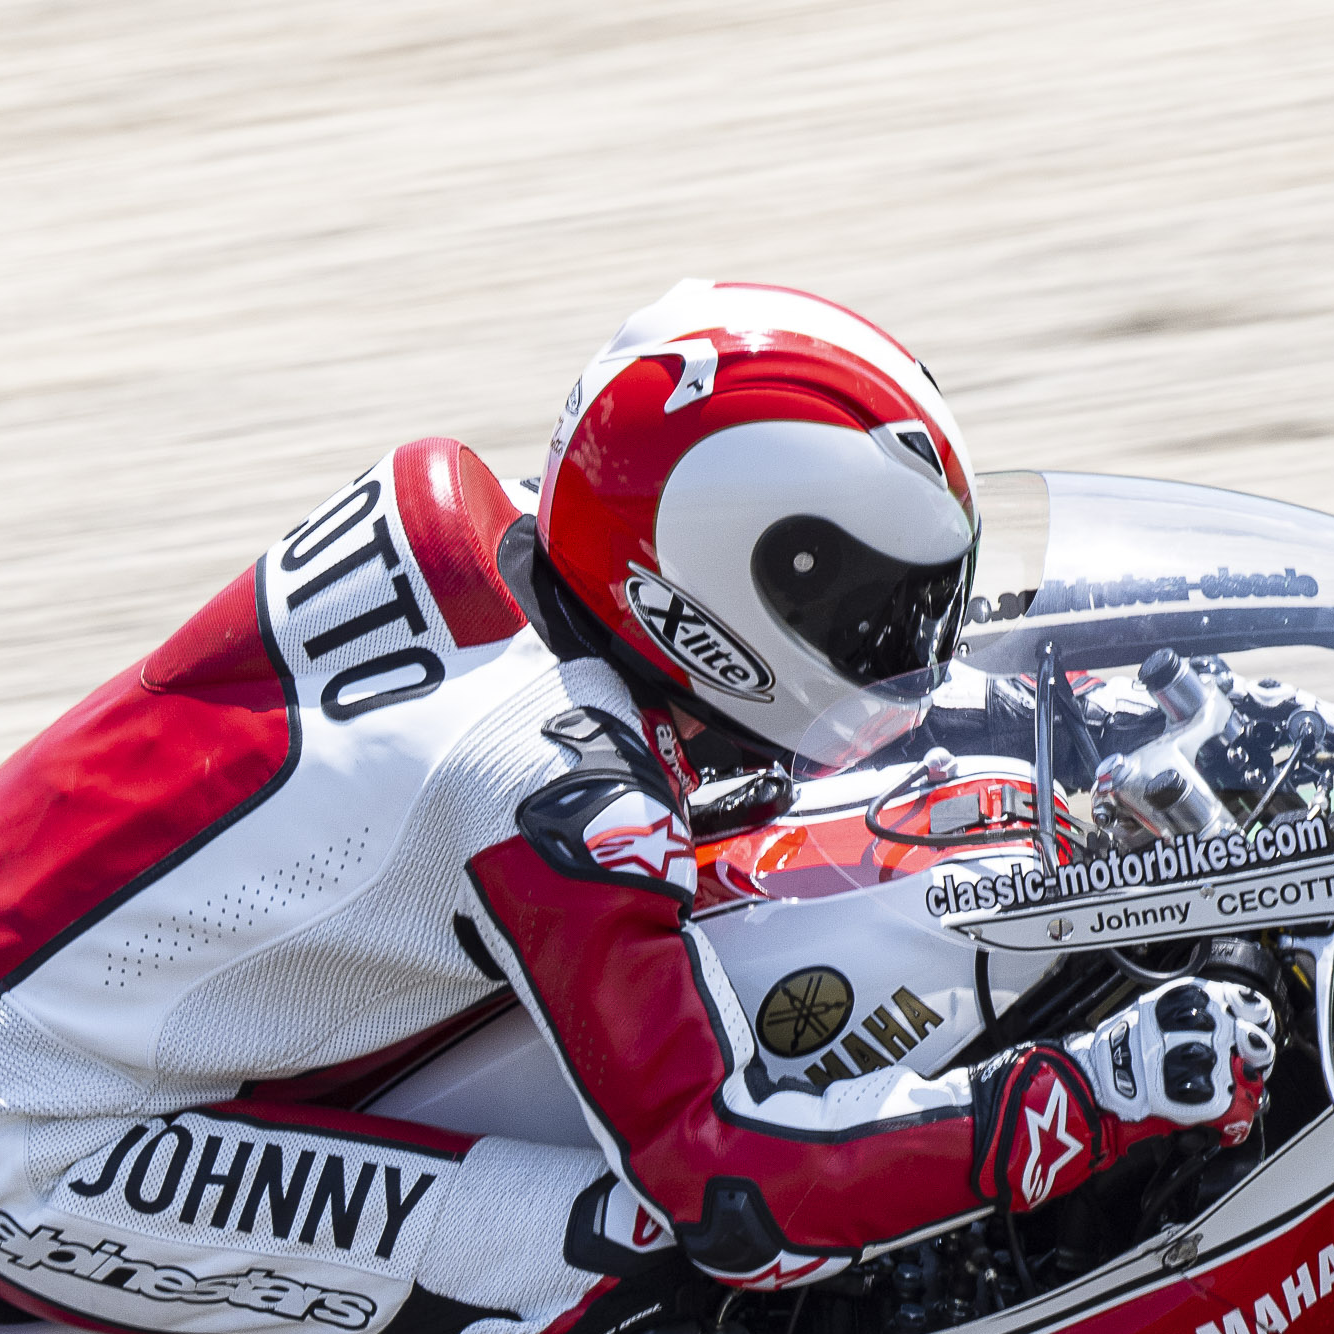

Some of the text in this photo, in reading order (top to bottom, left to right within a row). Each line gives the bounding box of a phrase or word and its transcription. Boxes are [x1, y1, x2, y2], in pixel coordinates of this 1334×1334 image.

[279, 466, 446, 723] OTTO
[635, 592, 751, 685] X-lite
[925, 814, 1329, 918] classic-motorbikes.com
[1089, 901, 1191, 934] Johnny
[803, 984, 945, 1087] MAHA
[68, 1118, 438, 1261] JOHNNY
